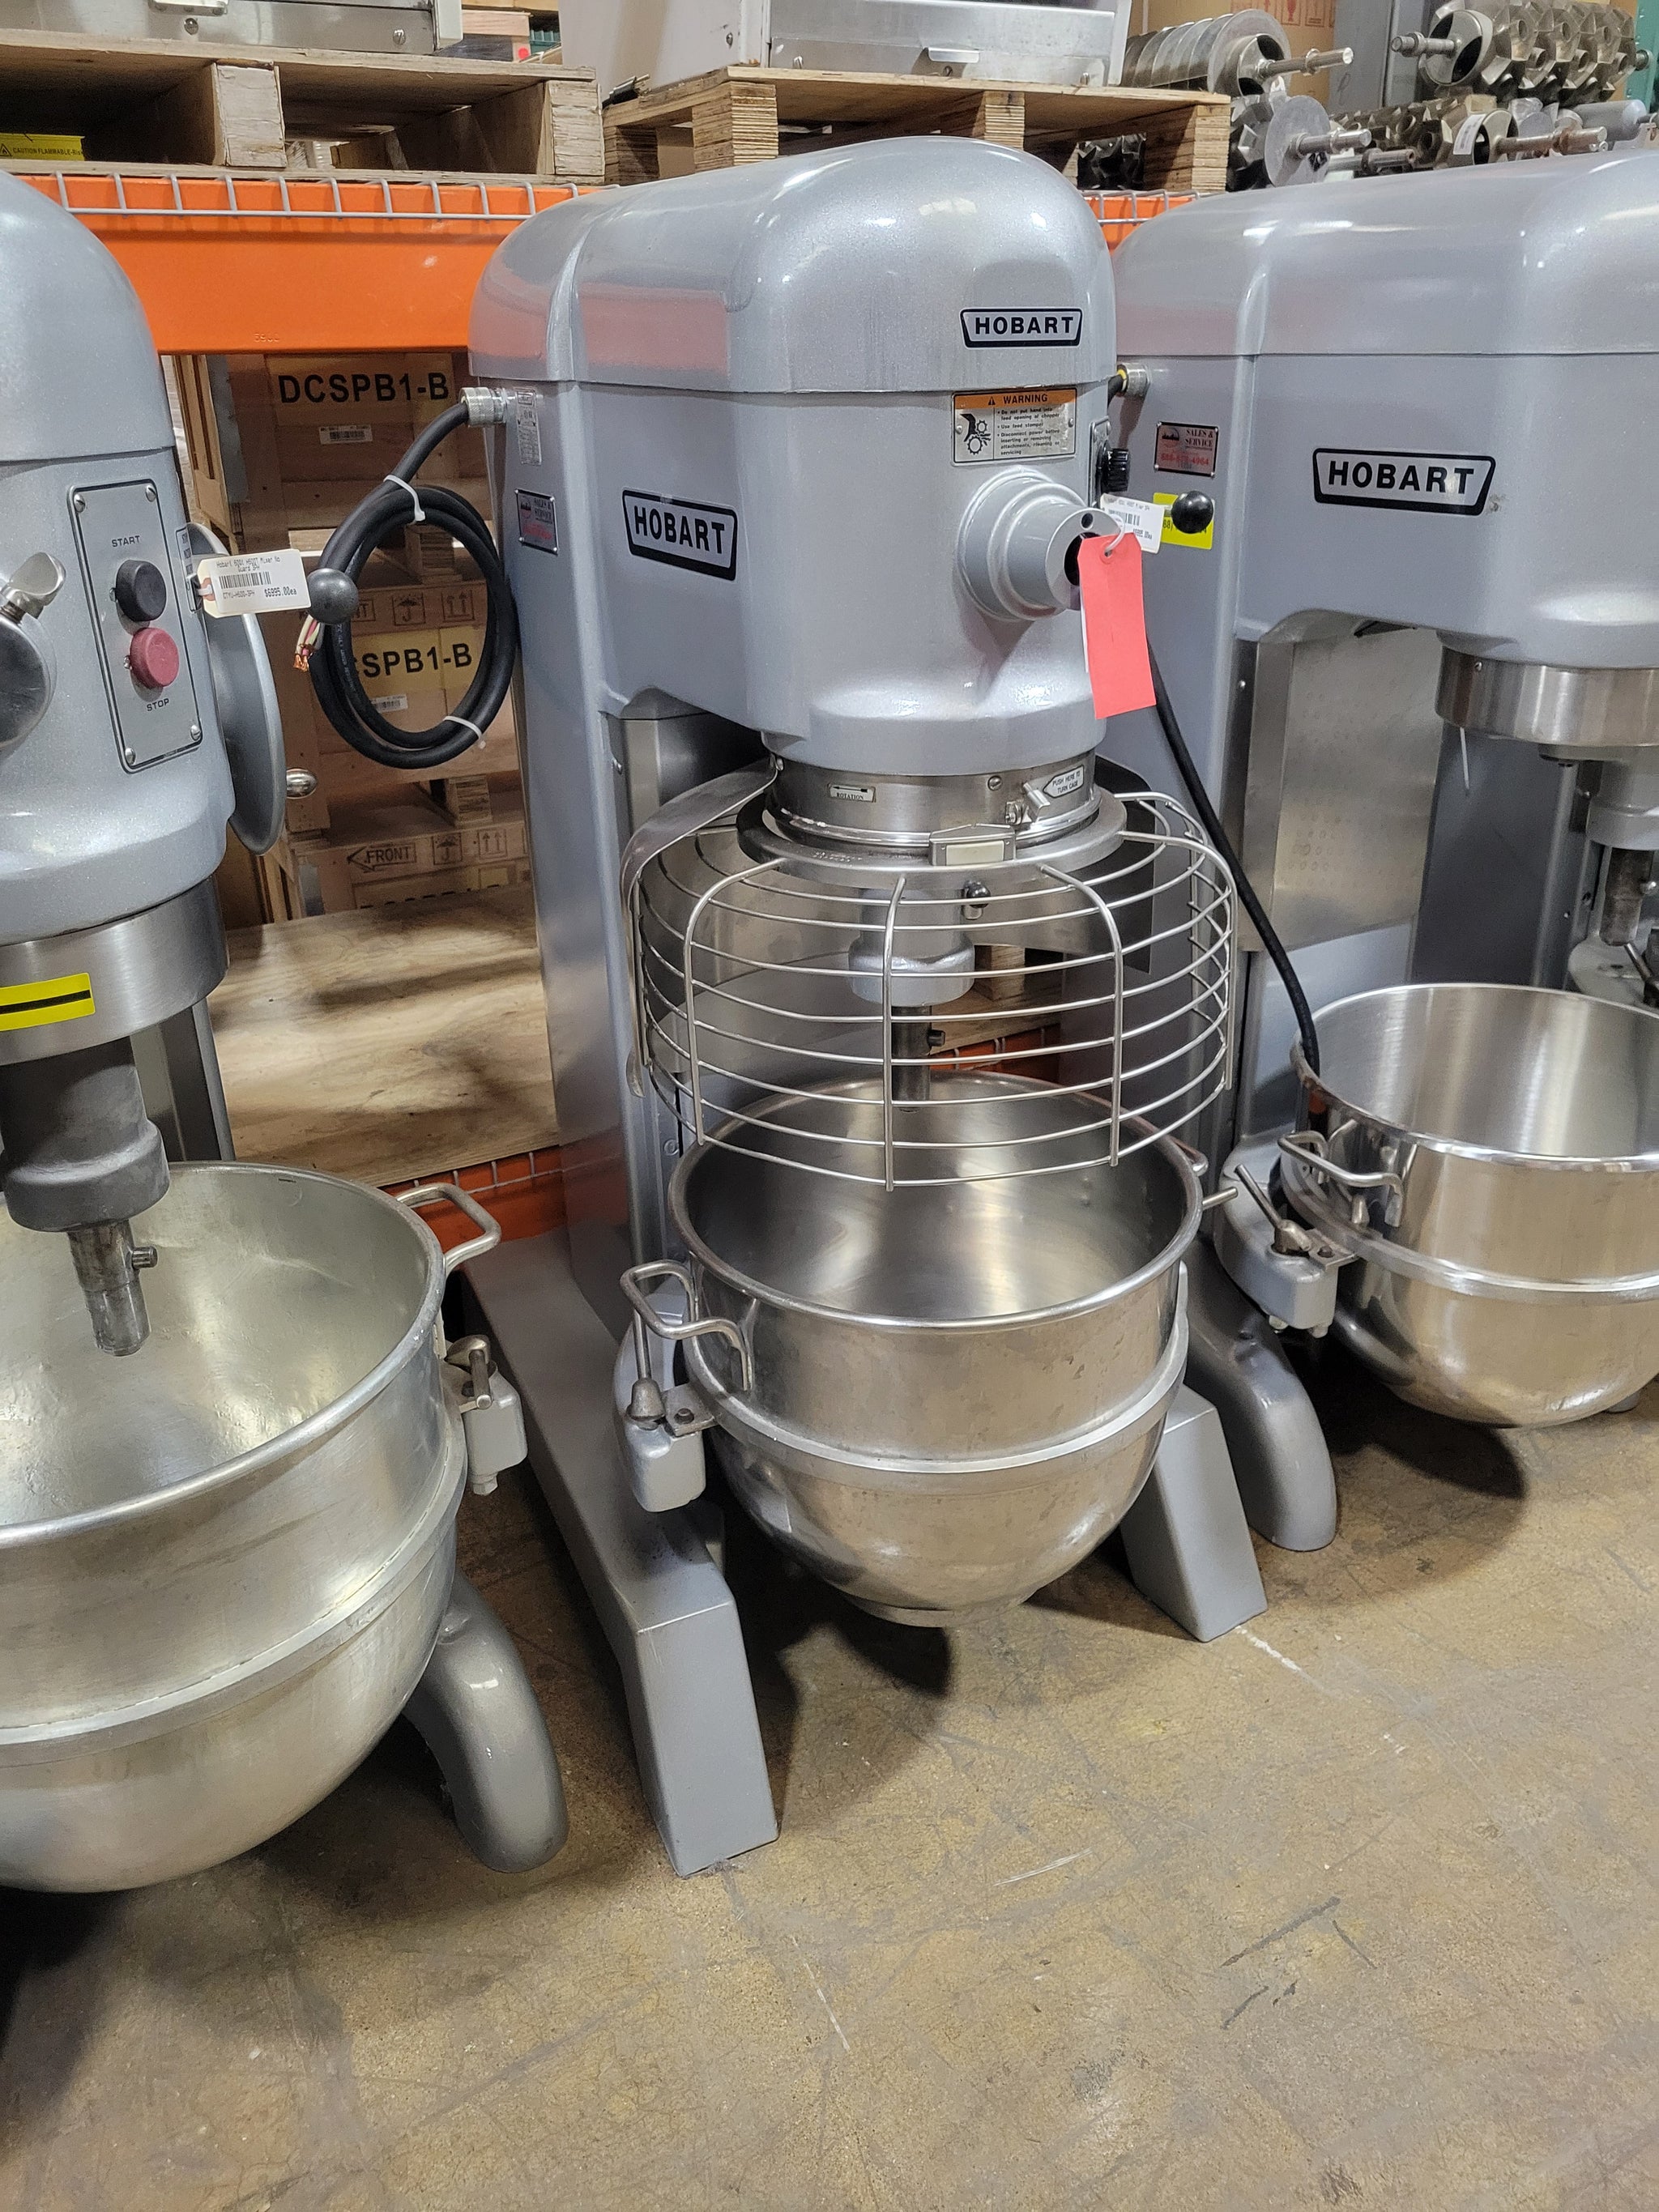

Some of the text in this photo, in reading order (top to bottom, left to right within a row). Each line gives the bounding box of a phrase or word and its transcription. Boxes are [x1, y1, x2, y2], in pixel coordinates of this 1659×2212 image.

[975, 317, 1074, 335] HOBART
[278, 372, 450, 404] DCSPB1-B
[1003, 394, 1048, 404] WARNING
[1186, 428, 1207, 437] SALES
[1185, 438, 1213, 447] SERVICE
[1328, 460, 1474, 495] HOBART
[634, 505, 725, 555] HOBART
[112, 535, 140, 547] START
[264, 586, 297, 598] $6995.00ea
[354, 643, 472, 679] SPB1-B
[147, 698, 170, 711] STOP
[1052, 777, 1064, 786] PUSH
[1057, 786, 1068, 794] TURN
[836, 792, 864, 801] ROTATION
[366, 846, 411, 864] FRONT
